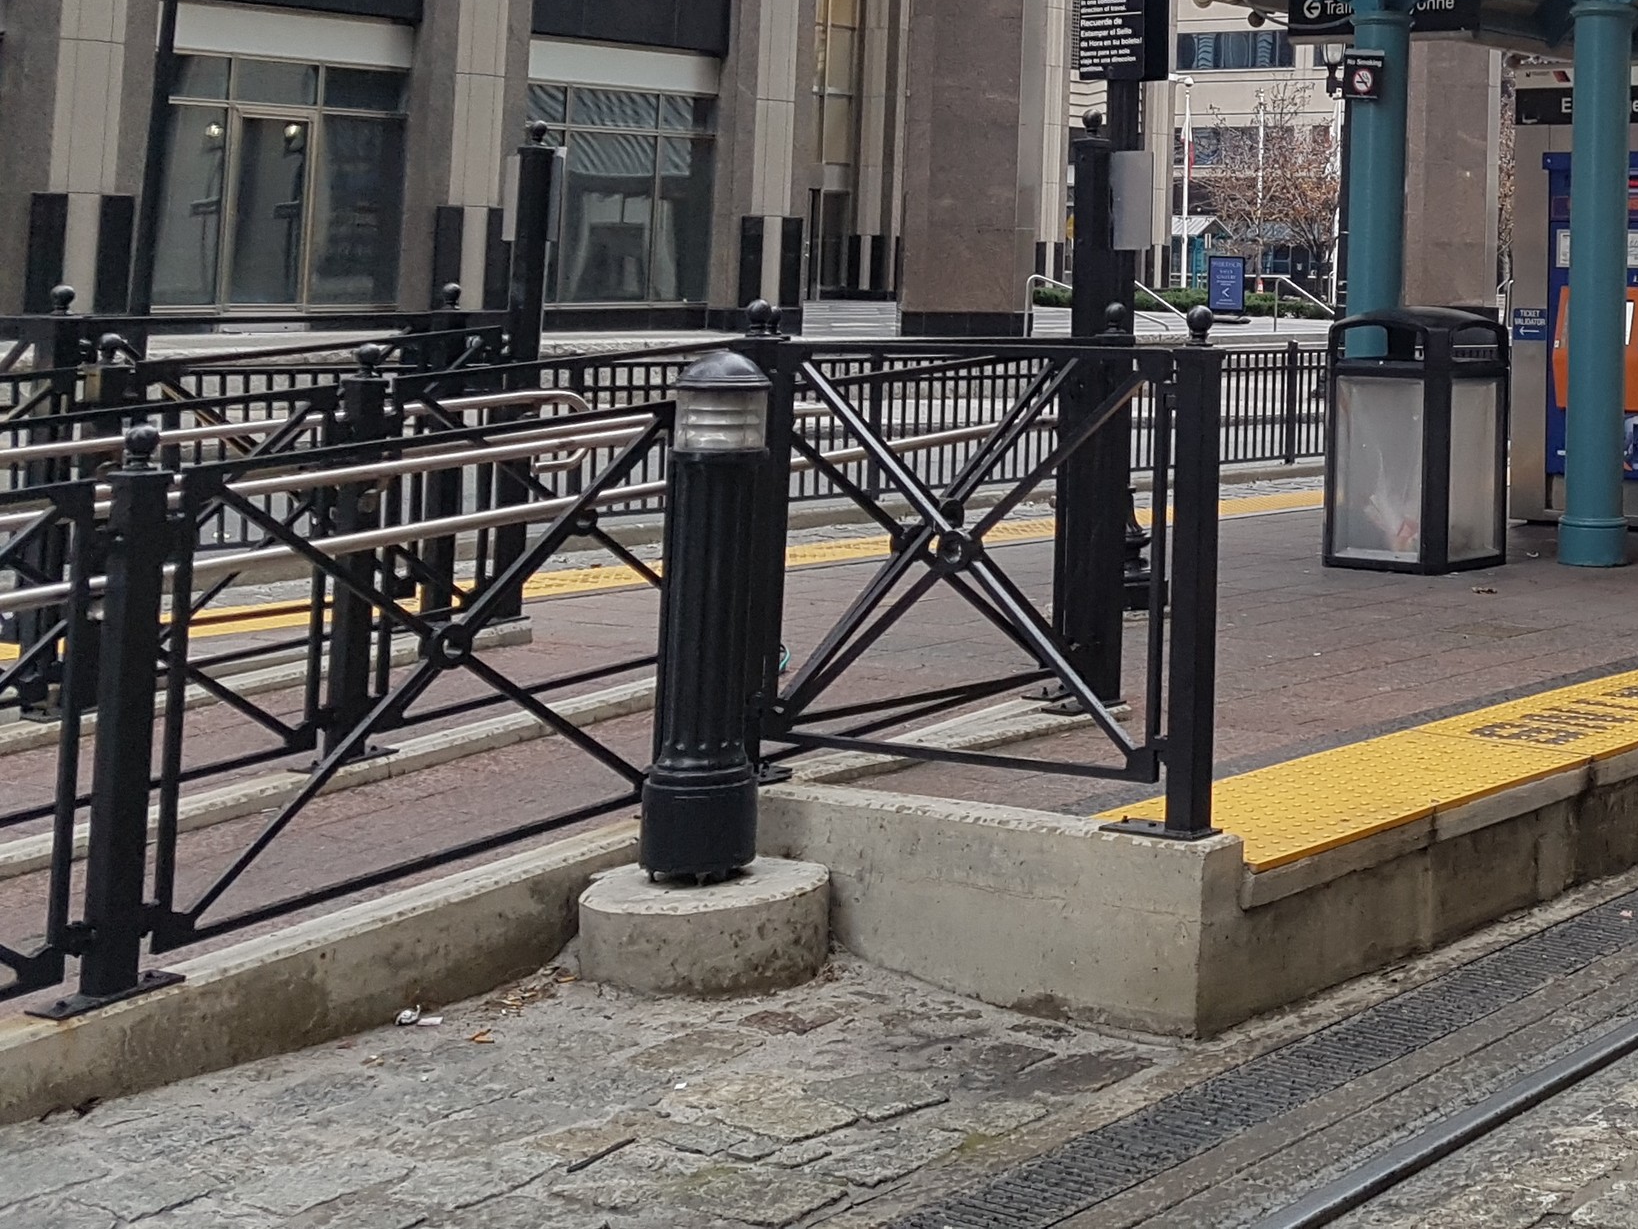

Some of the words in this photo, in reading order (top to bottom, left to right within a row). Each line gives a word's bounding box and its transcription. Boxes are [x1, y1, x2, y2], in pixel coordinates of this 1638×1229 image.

[1114, 17, 1122, 25] de
[1356, 58, 1382, 68] Smoking
[1520, 309, 1540, 318] TICKET
[1514, 317, 1546, 326] VALIDATOR
